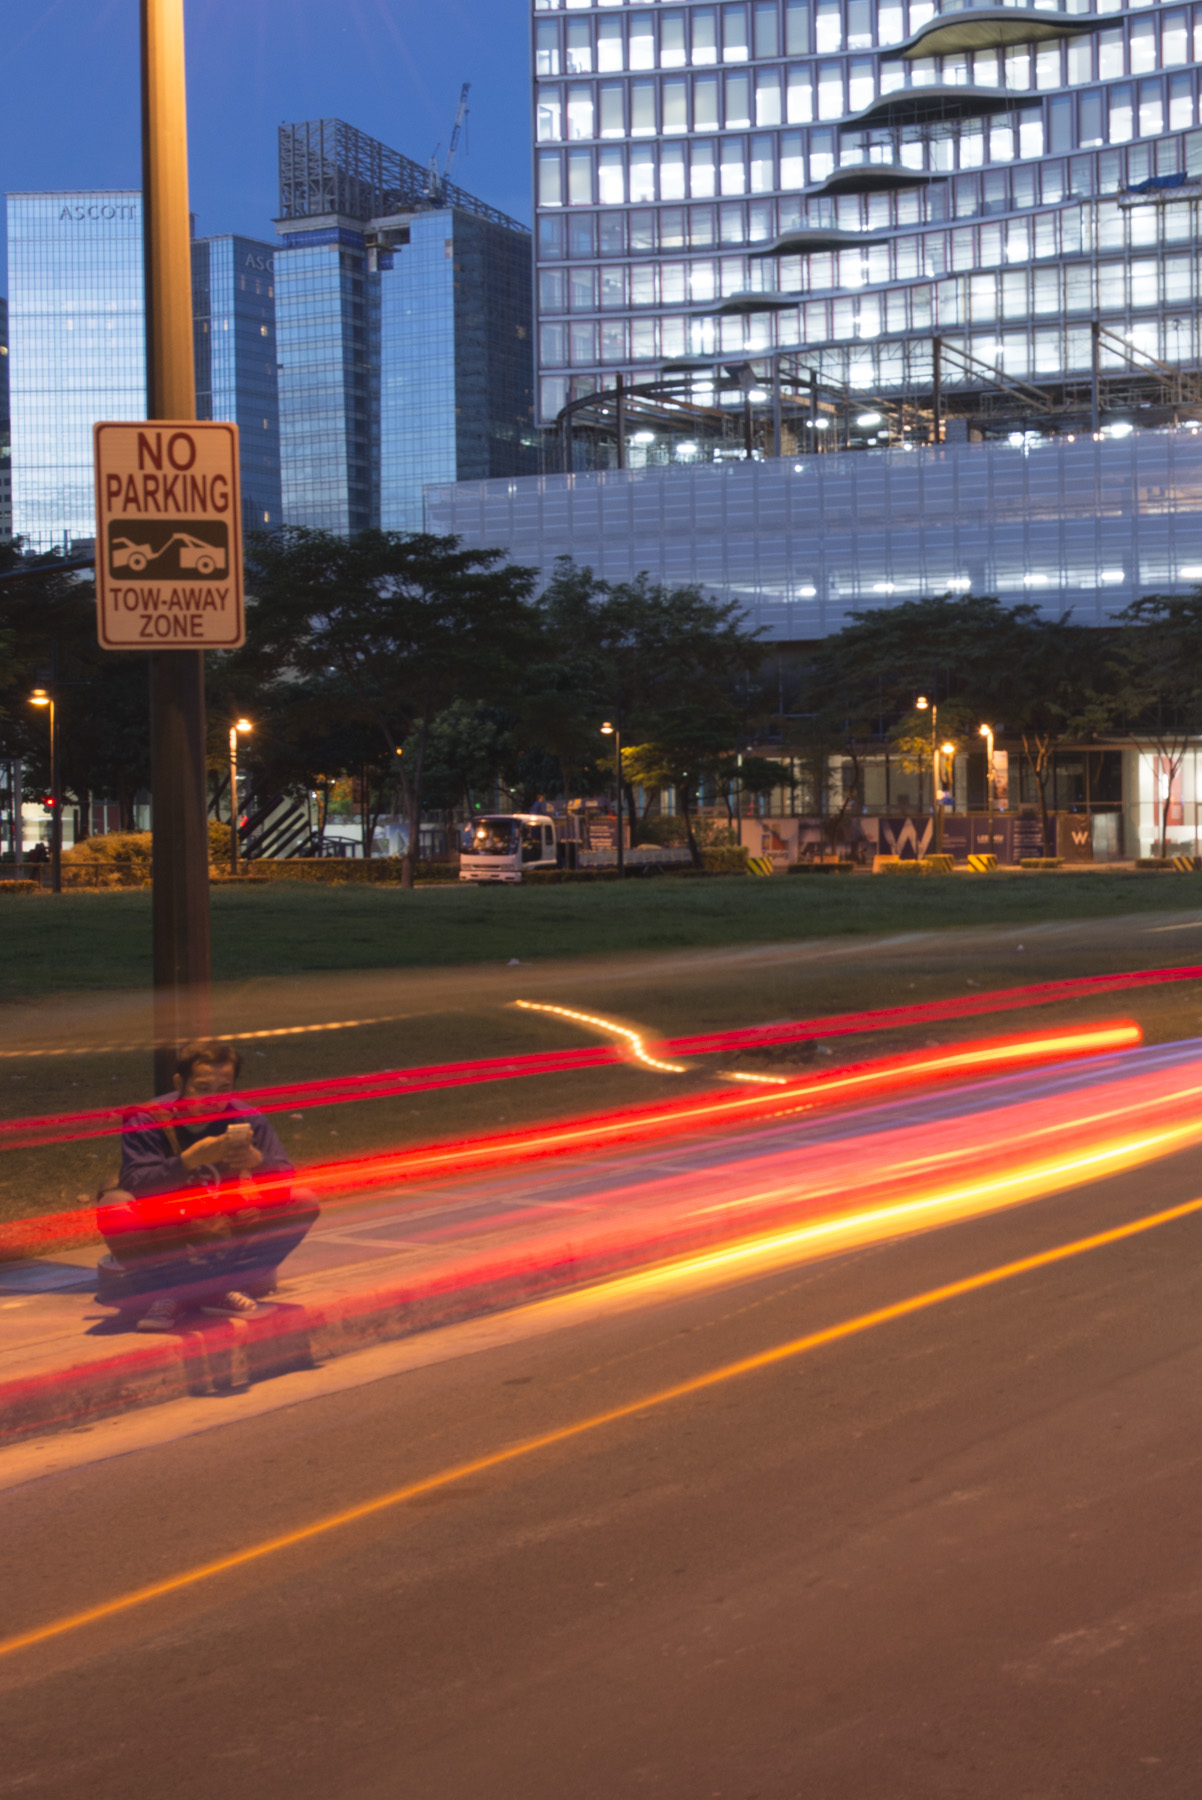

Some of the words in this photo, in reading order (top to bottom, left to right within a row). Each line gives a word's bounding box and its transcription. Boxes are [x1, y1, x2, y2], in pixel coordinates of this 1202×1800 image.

[59, 205, 137, 221] ASCOTT
[137, 432, 196, 471] NO
[106, 474, 229, 513] PARKING
[109, 588, 229, 611] TOW-AWAY
[139, 614, 204, 638] ZONE
[1071, 830, 1089, 845] W
